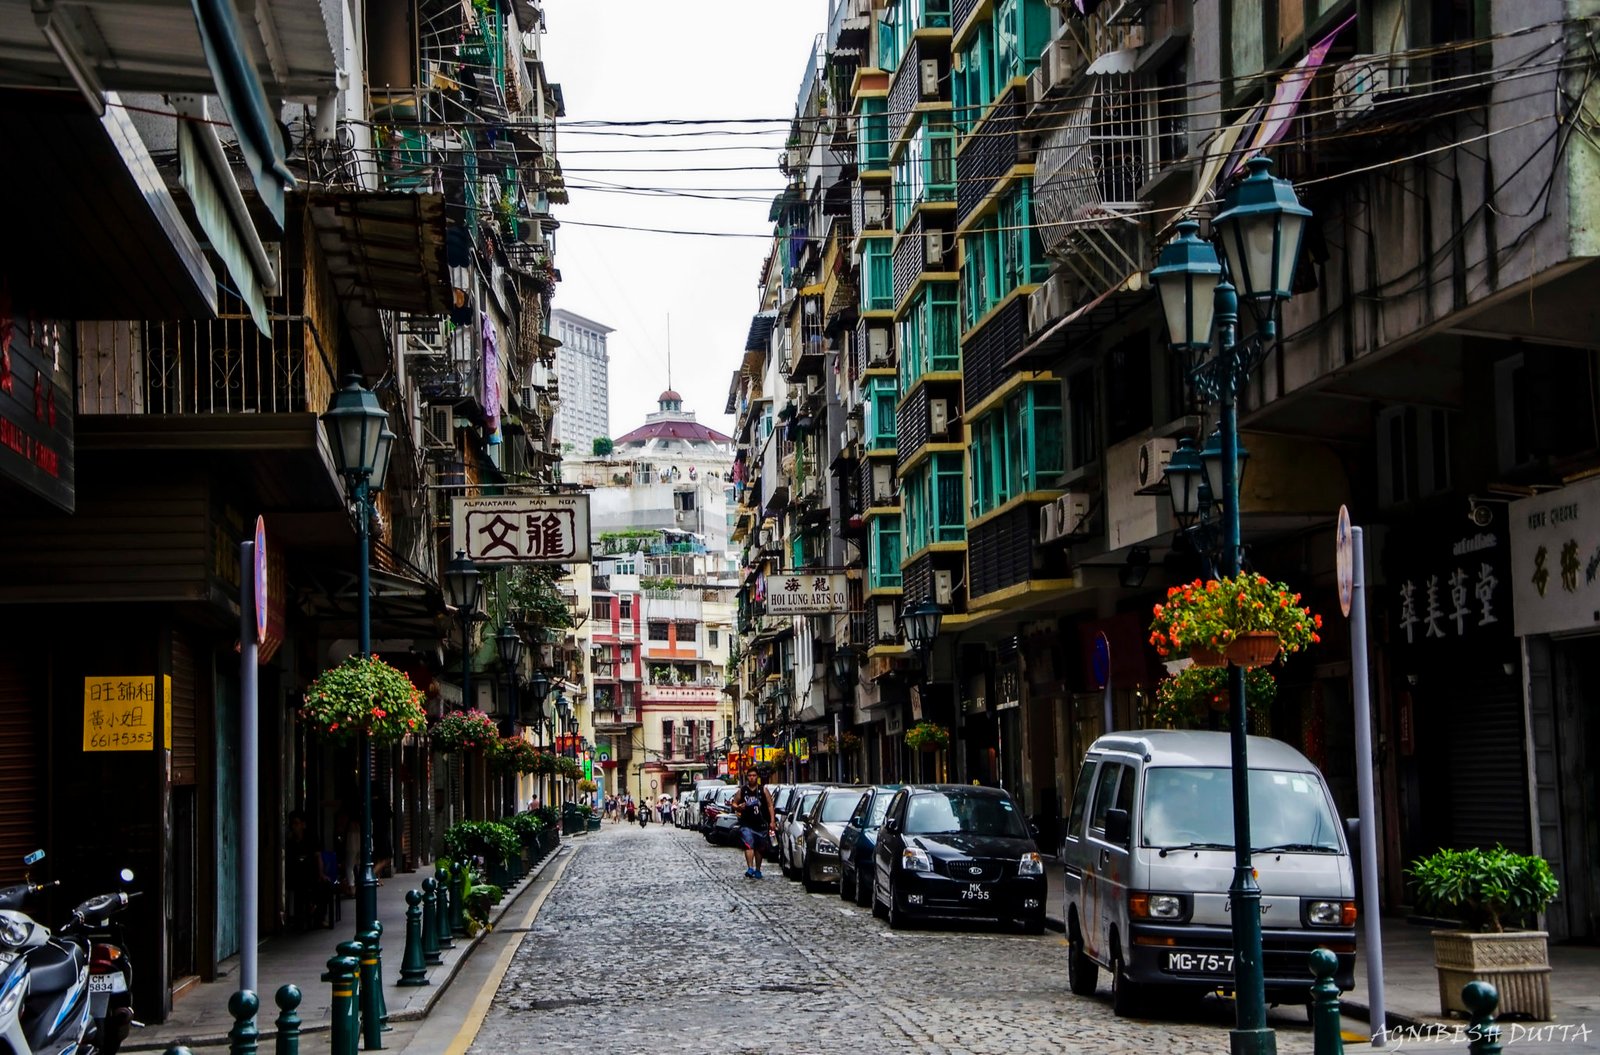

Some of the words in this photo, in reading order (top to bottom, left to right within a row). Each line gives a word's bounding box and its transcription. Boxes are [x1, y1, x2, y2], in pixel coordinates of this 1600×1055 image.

[771, 594, 786, 606] HOI
[788, 593, 809, 606] LUNG
[811, 593, 831, 605] ARTS
[90, 731, 153, 748] 66175353
[753, 805, 760, 815] 3
[969, 883, 981, 891] MK
[961, 890, 990, 900] 79-55
[1168, 953, 1235, 972] MG-75-7
[89, 983, 113, 992] 5834
